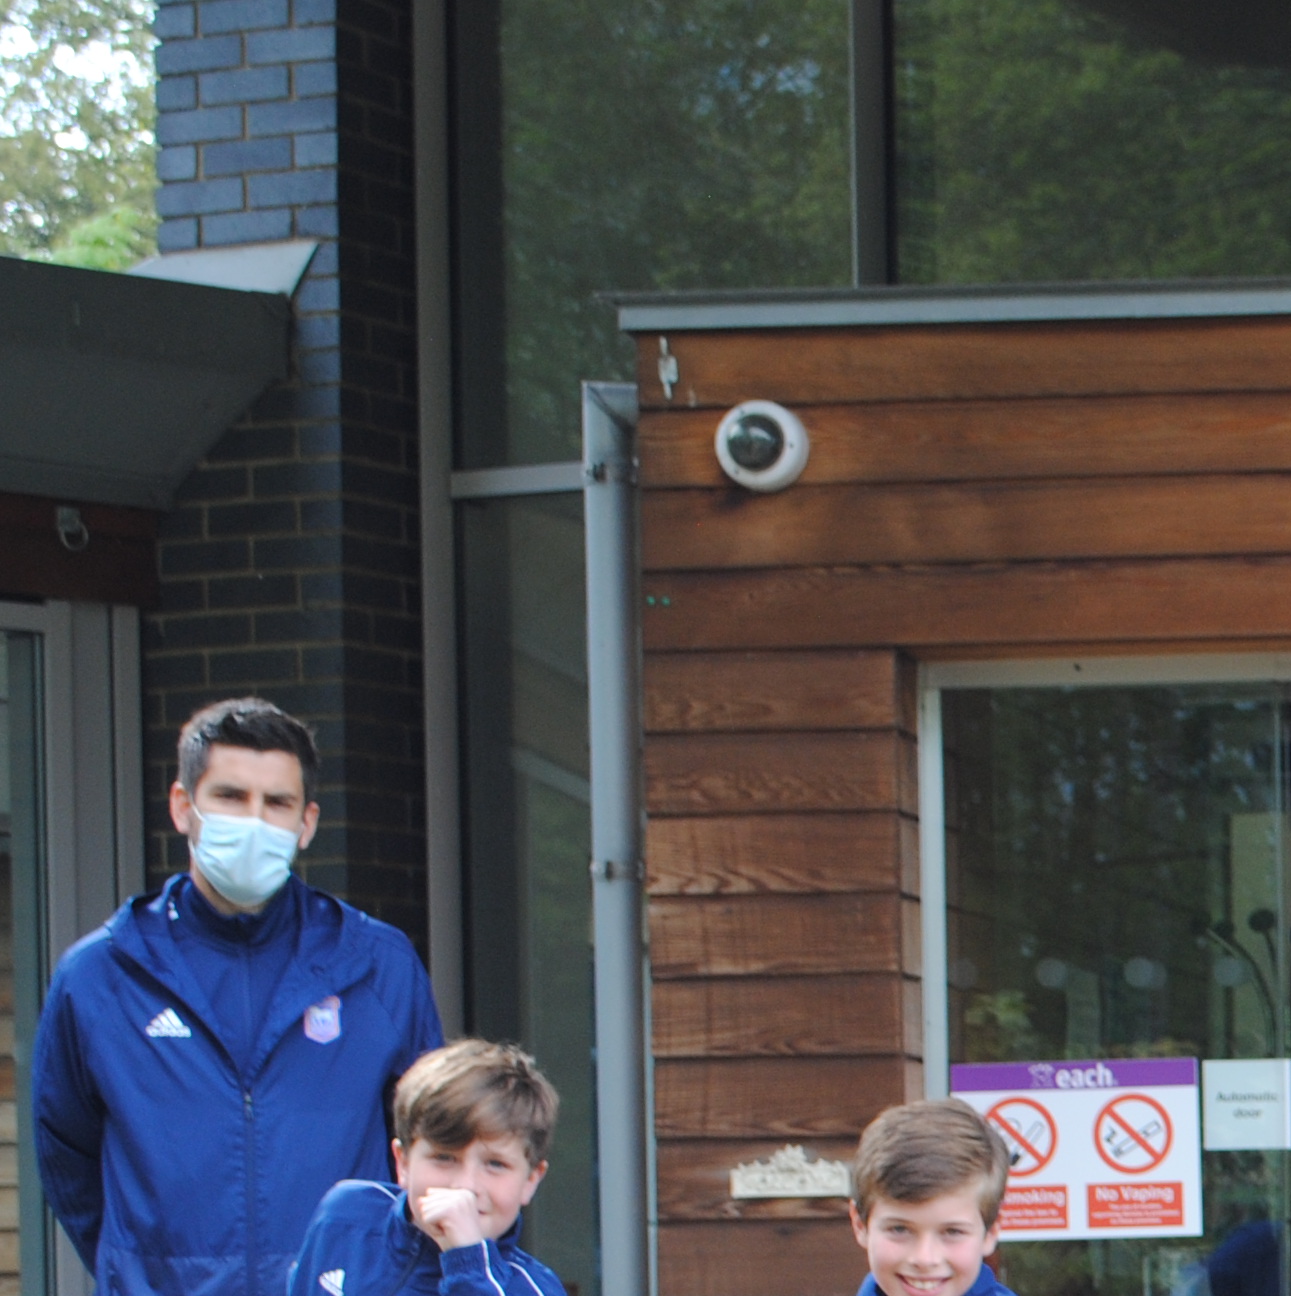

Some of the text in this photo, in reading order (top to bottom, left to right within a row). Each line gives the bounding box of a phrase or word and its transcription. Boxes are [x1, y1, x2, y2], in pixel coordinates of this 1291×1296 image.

[1055, 1063, 1114, 1089] each
[1215, 1090, 1277, 1103] Automatic
[1232, 1106, 1262, 1119] door
[1004, 1189, 1066, 1208] moking
[1095, 1184, 1175, 1204] No Vaping
